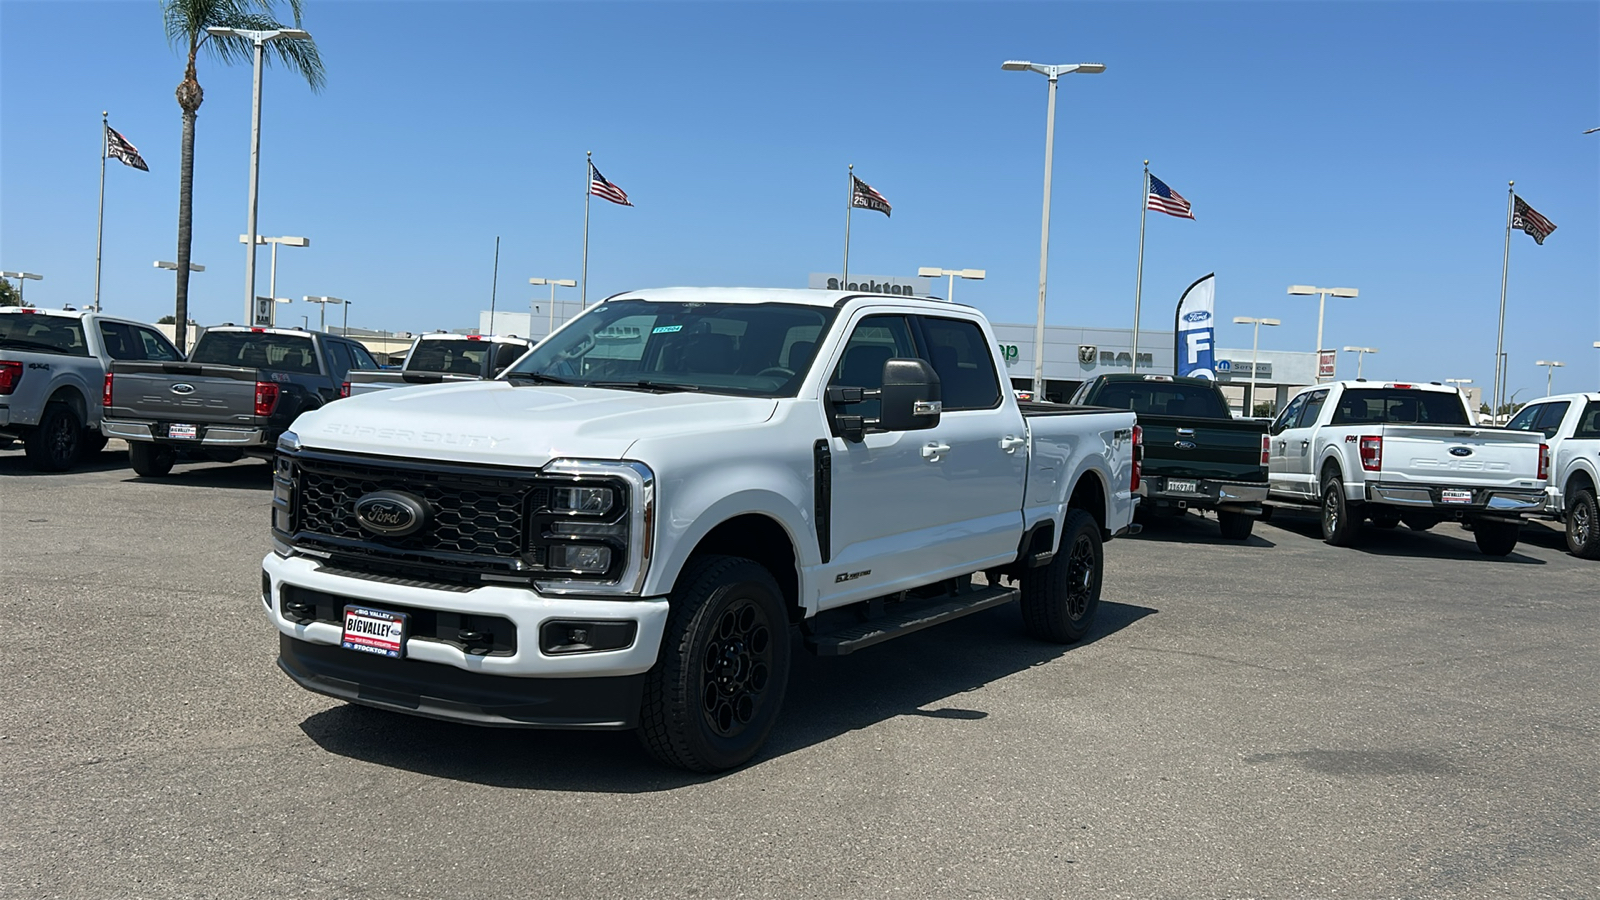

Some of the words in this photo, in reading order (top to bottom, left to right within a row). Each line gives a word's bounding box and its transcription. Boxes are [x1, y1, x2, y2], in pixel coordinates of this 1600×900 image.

[854, 196, 869, 207] 250
[827, 278, 913, 296] Stockton
[1100, 351, 1152, 363] RAM
[1234, 363, 1267, 371] Servce
[323, 423, 415, 440] SUPER
[421, 431, 510, 448] DUTY
[1409, 458, 1511, 472] F-150
[367, 503, 401, 524] Ford
[369, 611, 390, 619] VALLEY
[347, 618, 392, 637] BIGVALLEY
[353, 643, 388, 655] STOCKTON
